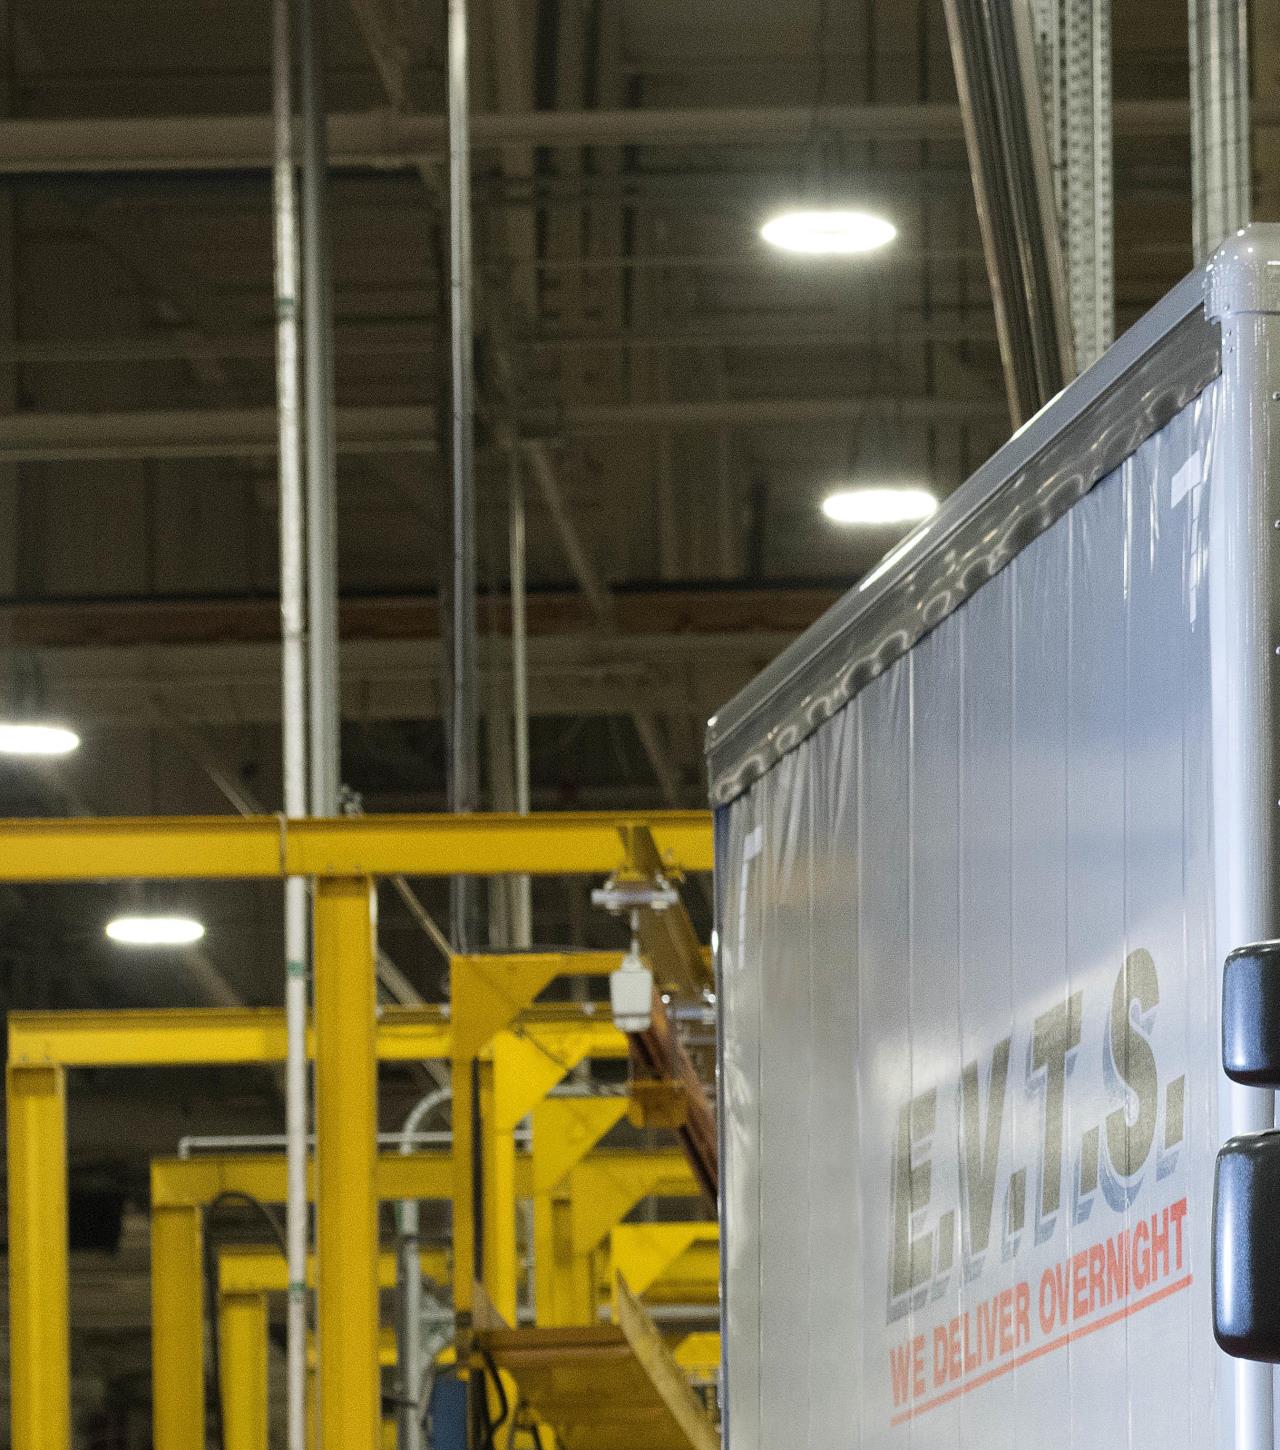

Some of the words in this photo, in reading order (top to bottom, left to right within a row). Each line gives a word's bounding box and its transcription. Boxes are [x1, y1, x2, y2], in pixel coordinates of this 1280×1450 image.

[886, 947, 1186, 1327] E.V.T.S.
[889, 1334, 926, 1408] WE
[932, 1283, 1031, 1384] DELIVER
[1039, 1196, 1188, 1335] OVERNIGHT
